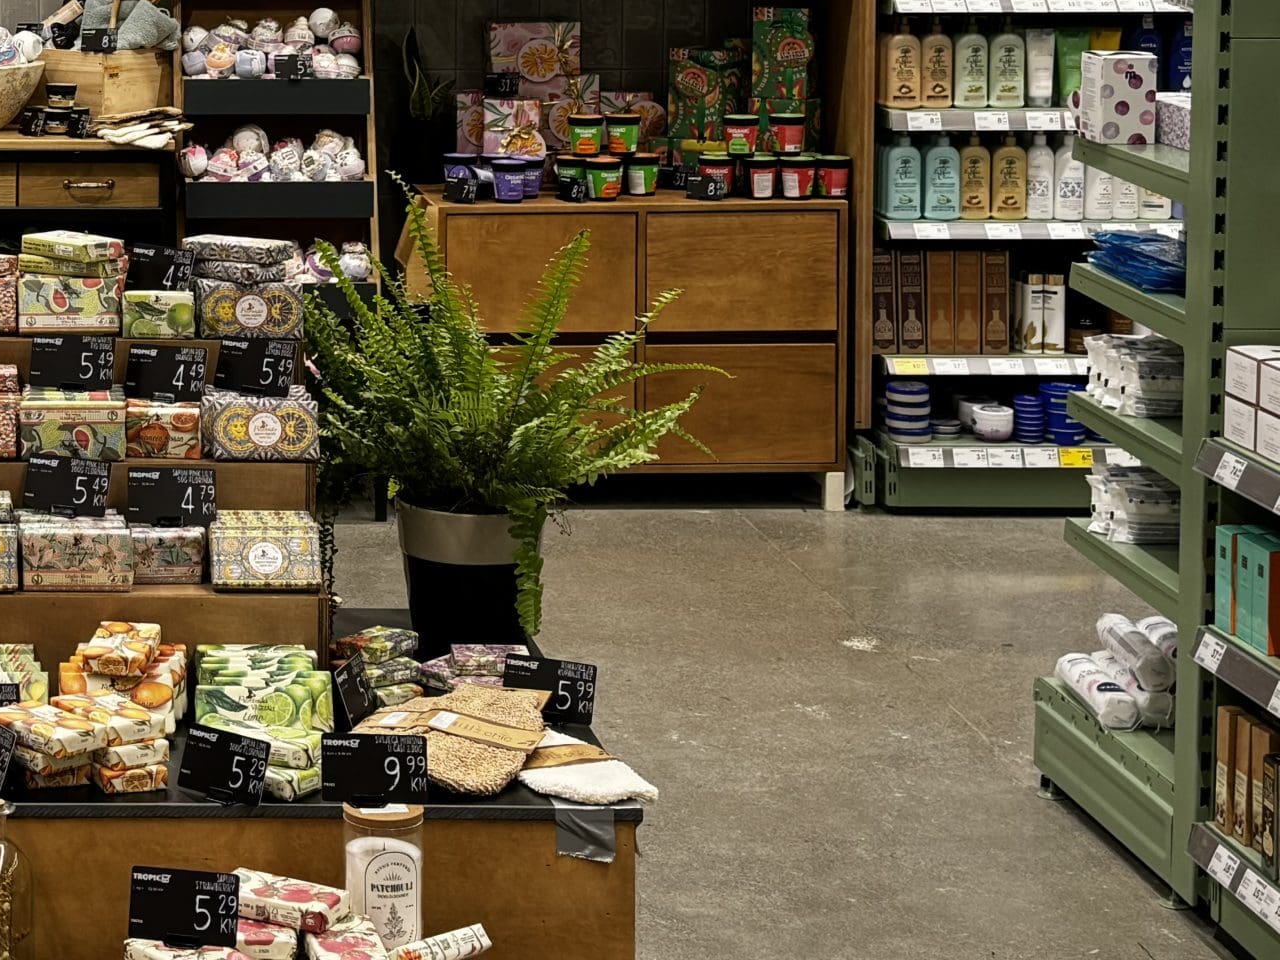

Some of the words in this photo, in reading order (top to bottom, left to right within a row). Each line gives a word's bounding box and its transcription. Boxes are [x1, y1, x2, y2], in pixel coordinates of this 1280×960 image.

[102, 36, 109, 48] 8
[297, 61, 305, 74] 5
[708, 183, 715, 196] 8
[162, 265, 174, 289] 4
[177, 265, 190, 279] 49
[79, 353, 93, 379] 5
[98, 352, 113, 366] 49
[259, 358, 274, 384] 5
[278, 359, 293, 373] 49
[99, 369, 112, 381] KM
[172, 364, 184, 390] 4
[189, 364, 204, 378] 49
[190, 381, 203, 392] KM
[73, 477, 87, 504] 5
[92, 478, 108, 492] 49
[93, 495, 107, 507] KM
[181, 486, 194, 515] 4
[199, 486, 215, 500] 79
[202, 502, 216, 515] KM
[555, 680, 571, 710] 5
[576, 681, 594, 698] 99
[578, 701, 593, 714] KM
[323, 739, 354, 748] TROPIC
[228, 756, 246, 788] 5
[250, 760, 266, 778] 29
[384, 756, 401, 791] 9
[406, 756, 426, 774] 99
[247, 780, 262, 794] KM
[410, 777, 427, 792] KM
[133, 872, 165, 882] TROPIC
[193, 894, 211, 930] 5
[218, 894, 236, 915] 29
[220, 918, 236, 934] KM
